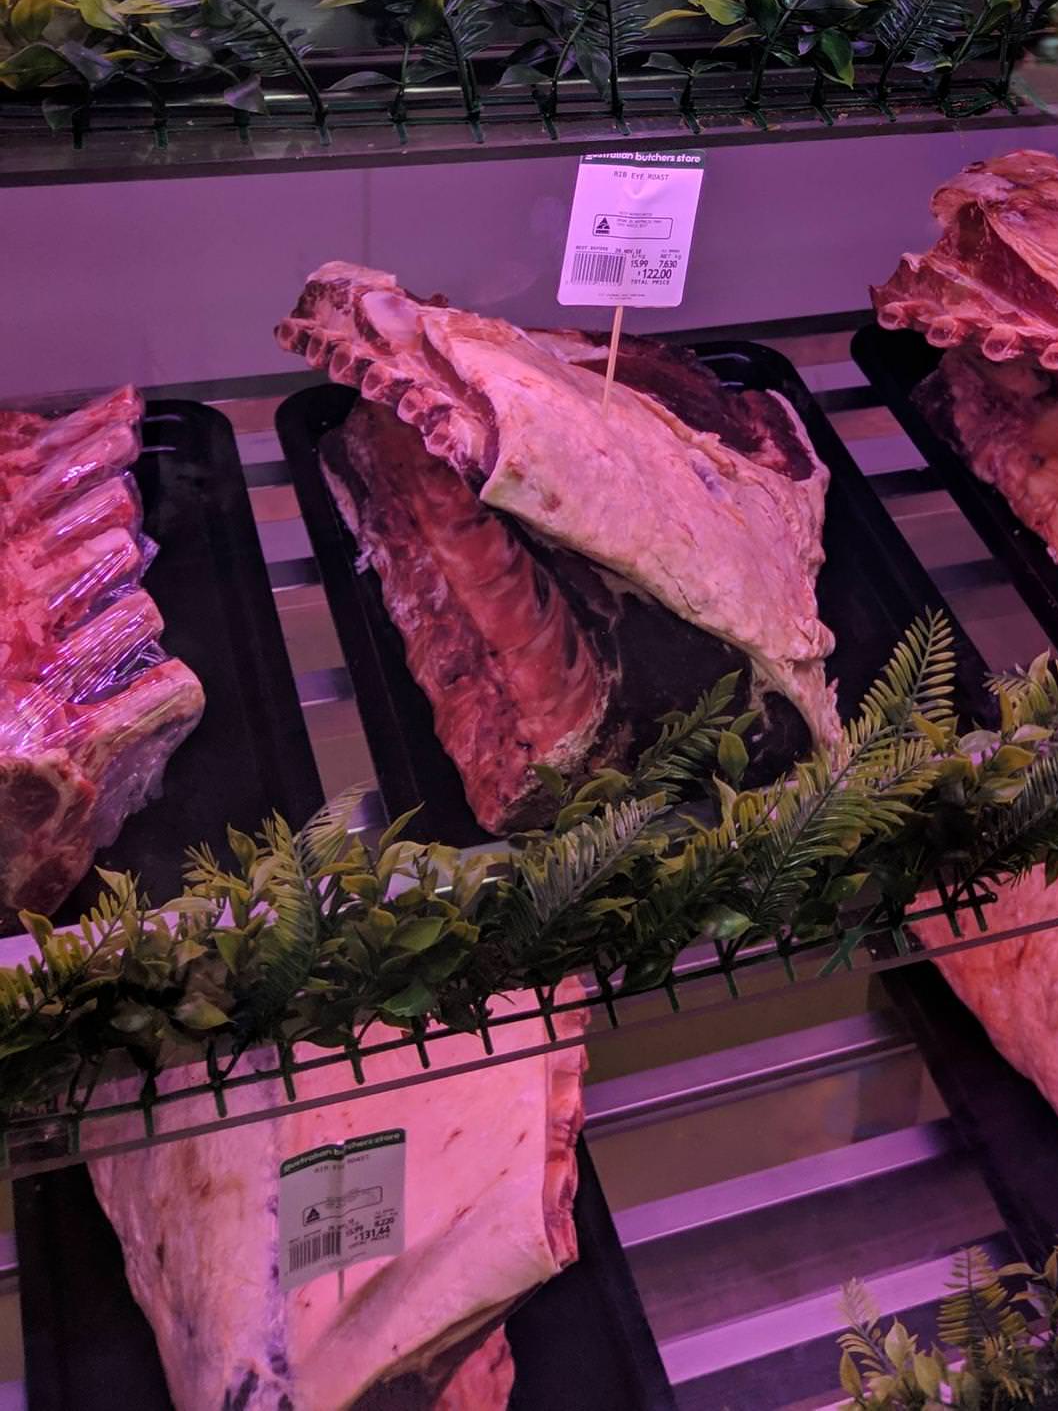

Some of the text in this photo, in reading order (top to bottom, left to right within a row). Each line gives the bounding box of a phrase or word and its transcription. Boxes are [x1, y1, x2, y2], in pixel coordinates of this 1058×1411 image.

[635, 152, 675, 162] butchers
[676, 154, 701, 163] store
[647, 173, 670, 181] ROAST
[630, 260, 678, 269] 15.99 7.630
